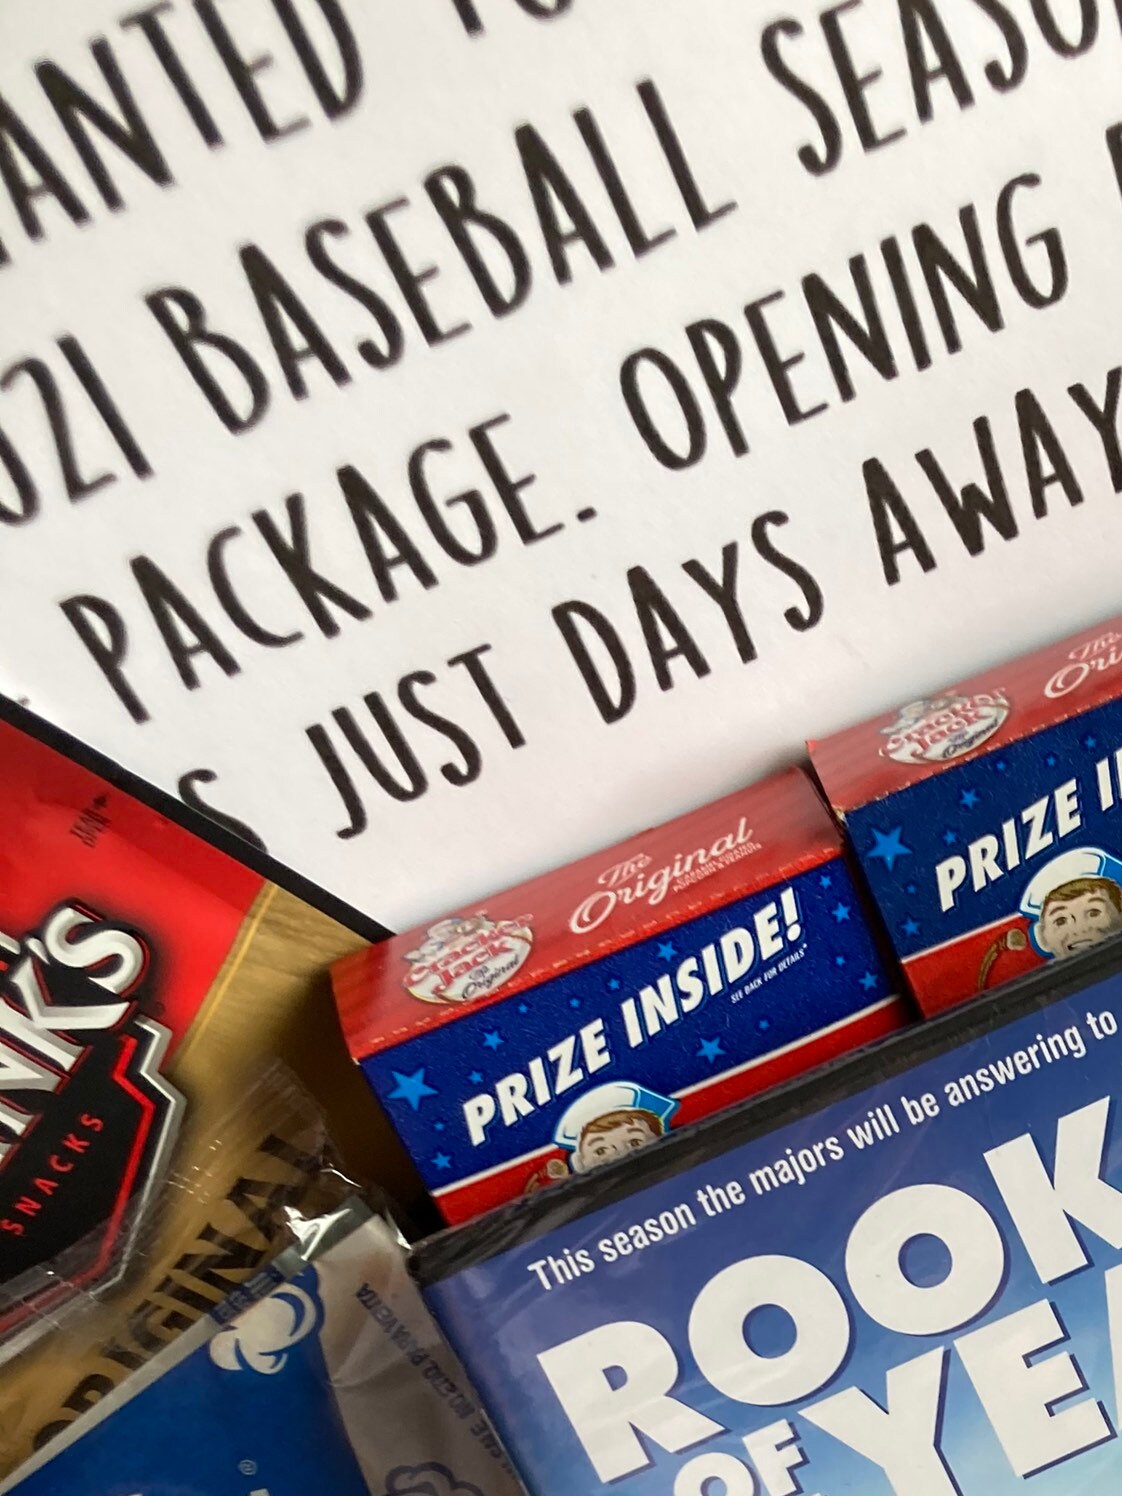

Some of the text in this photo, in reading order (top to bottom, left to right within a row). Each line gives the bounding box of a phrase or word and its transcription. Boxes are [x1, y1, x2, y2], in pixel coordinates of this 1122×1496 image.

[0, 0, 365, 266] ANTED
[144, 77, 738, 437] BASEBALL
[59, 413, 598, 725] PACKAGE.
[619, 172, 1070, 471] OPENING
[304, 643, 527, 840] JUST
[551, 510, 825, 725] DAYS
[568, 817, 753, 935] Original
[597, 852, 653, 888] The
[934, 777, 1082, 913] PRIZE
[461, 886, 802, 1147] PRIZE INSIDE!
[1, 1112, 104, 1238] SNACKS
[527, 1248, 595, 1291] This
[598, 1202, 697, 1264] season
[697, 1180, 746, 1218] the
[749, 1133, 845, 1196] majors
[847, 1103, 901, 1151] will
[900, 1090, 941, 1126] be
[943, 1024, 1087, 1108] answering
[1086, 1010, 1118, 1041] to
